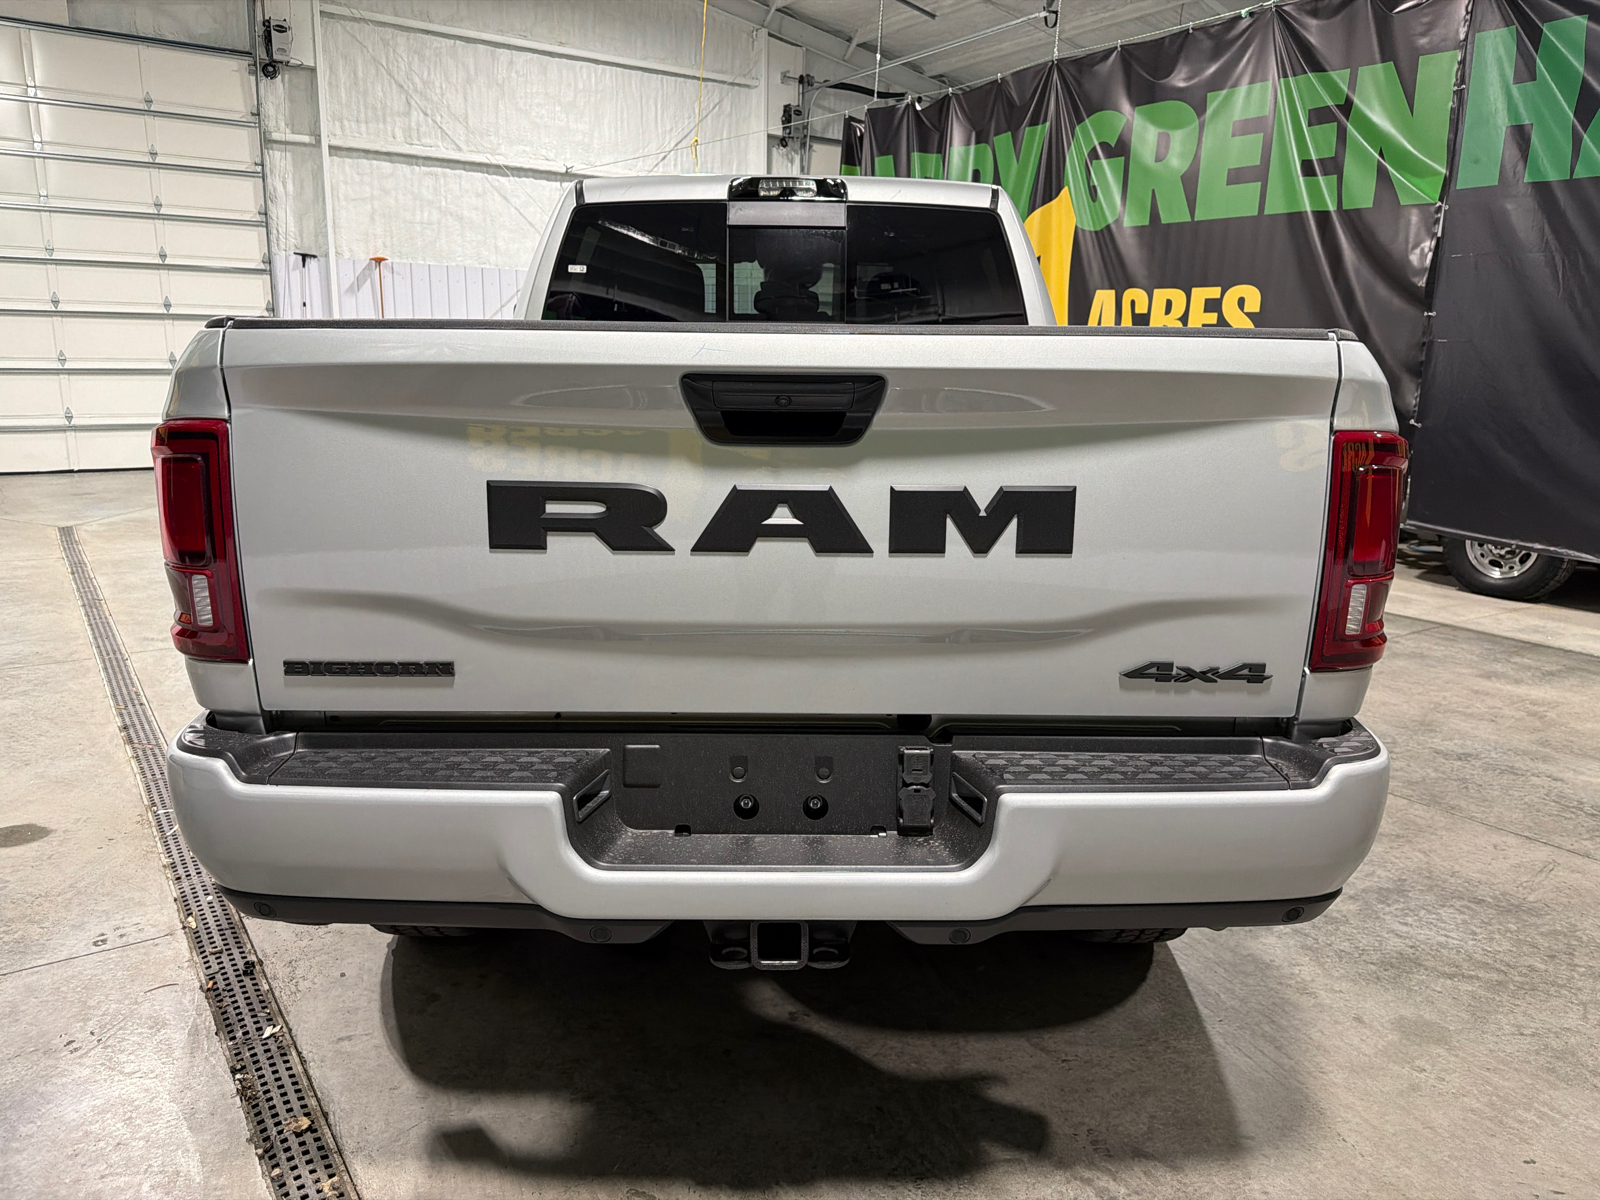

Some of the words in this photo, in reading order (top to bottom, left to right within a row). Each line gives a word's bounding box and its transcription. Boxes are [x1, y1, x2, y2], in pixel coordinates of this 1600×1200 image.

[1064, 50, 1459, 231] GREEN
[486, 480, 1077, 555] RAM
[283, 660, 455, 677] BIGHORN
[1119, 661, 1273, 684] 4x4
